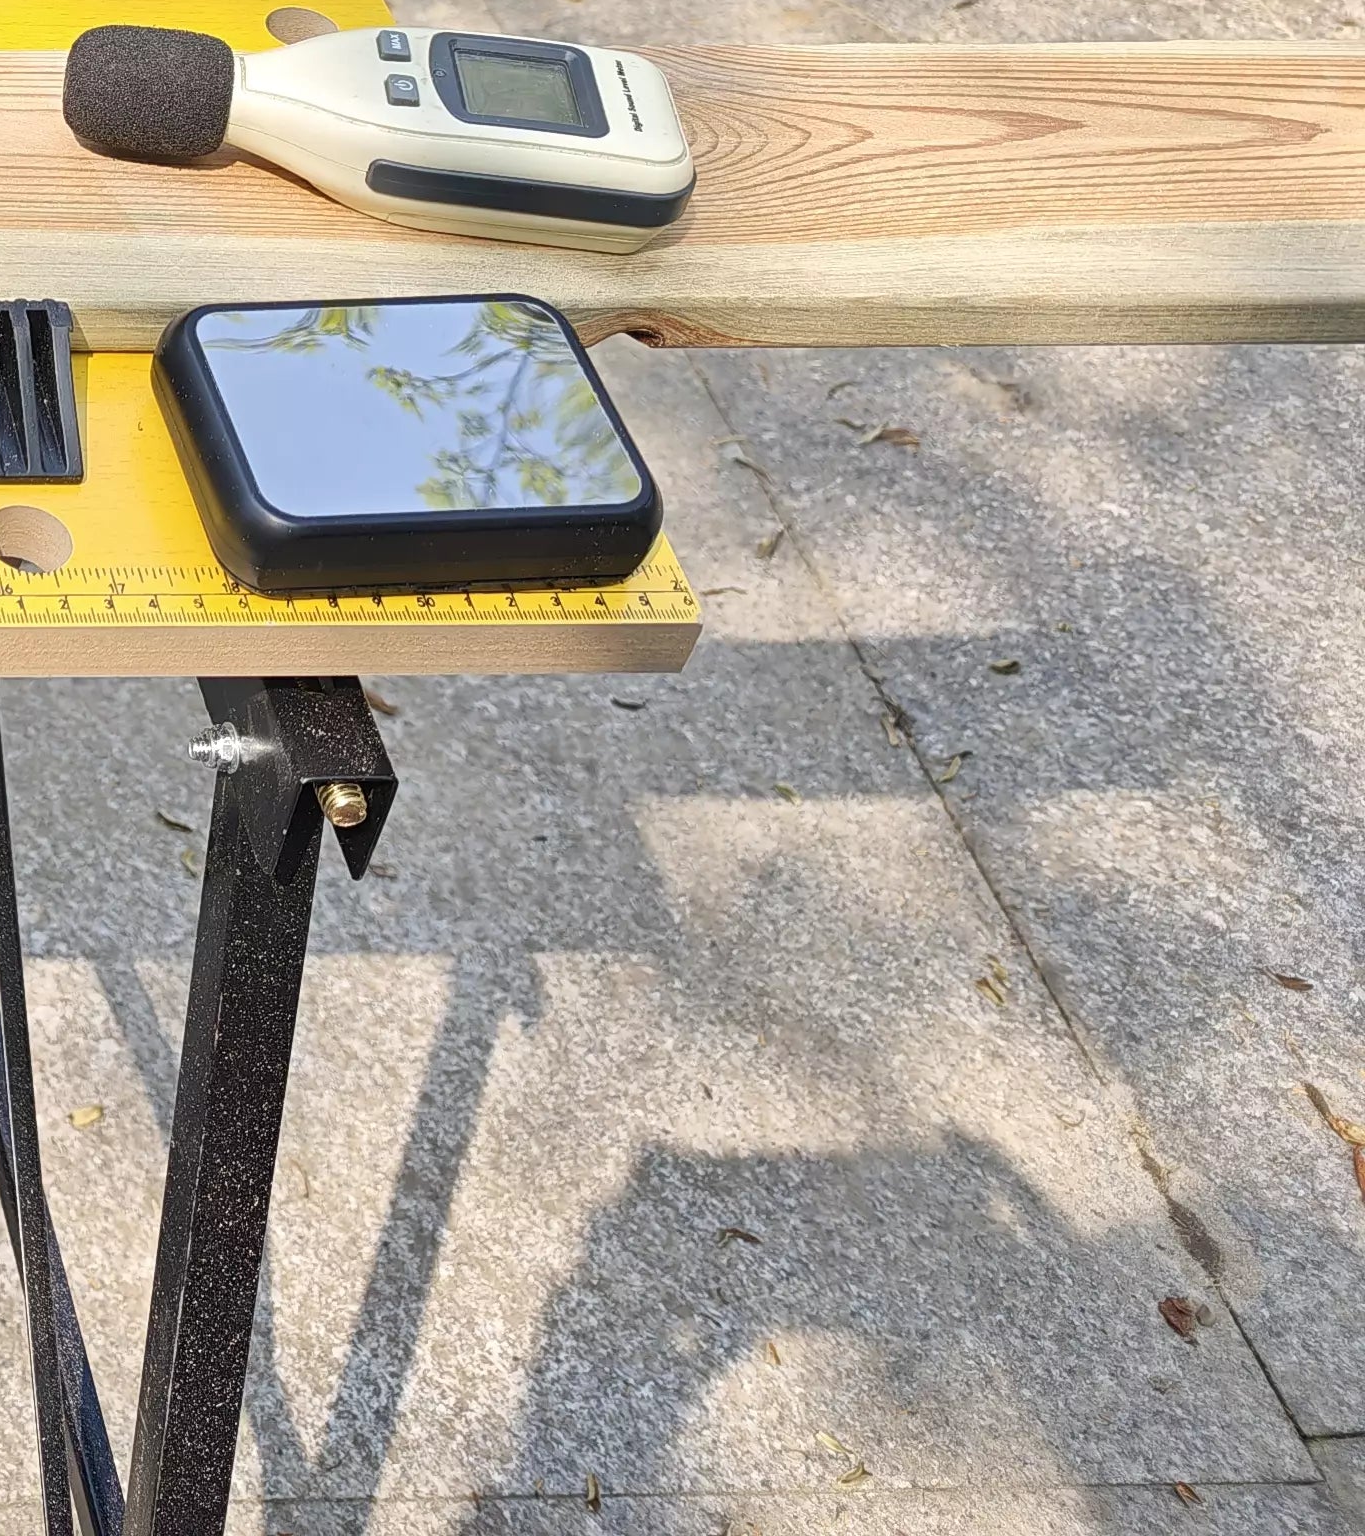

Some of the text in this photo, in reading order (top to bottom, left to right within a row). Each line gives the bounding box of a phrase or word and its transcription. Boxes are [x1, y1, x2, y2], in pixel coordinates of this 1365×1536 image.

[389, 33, 402, 49] MAX
[615, 60, 643, 132] Digital Sound Level Meter
[108, 583, 125, 594] 17
[223, 582, 240, 593] 18
